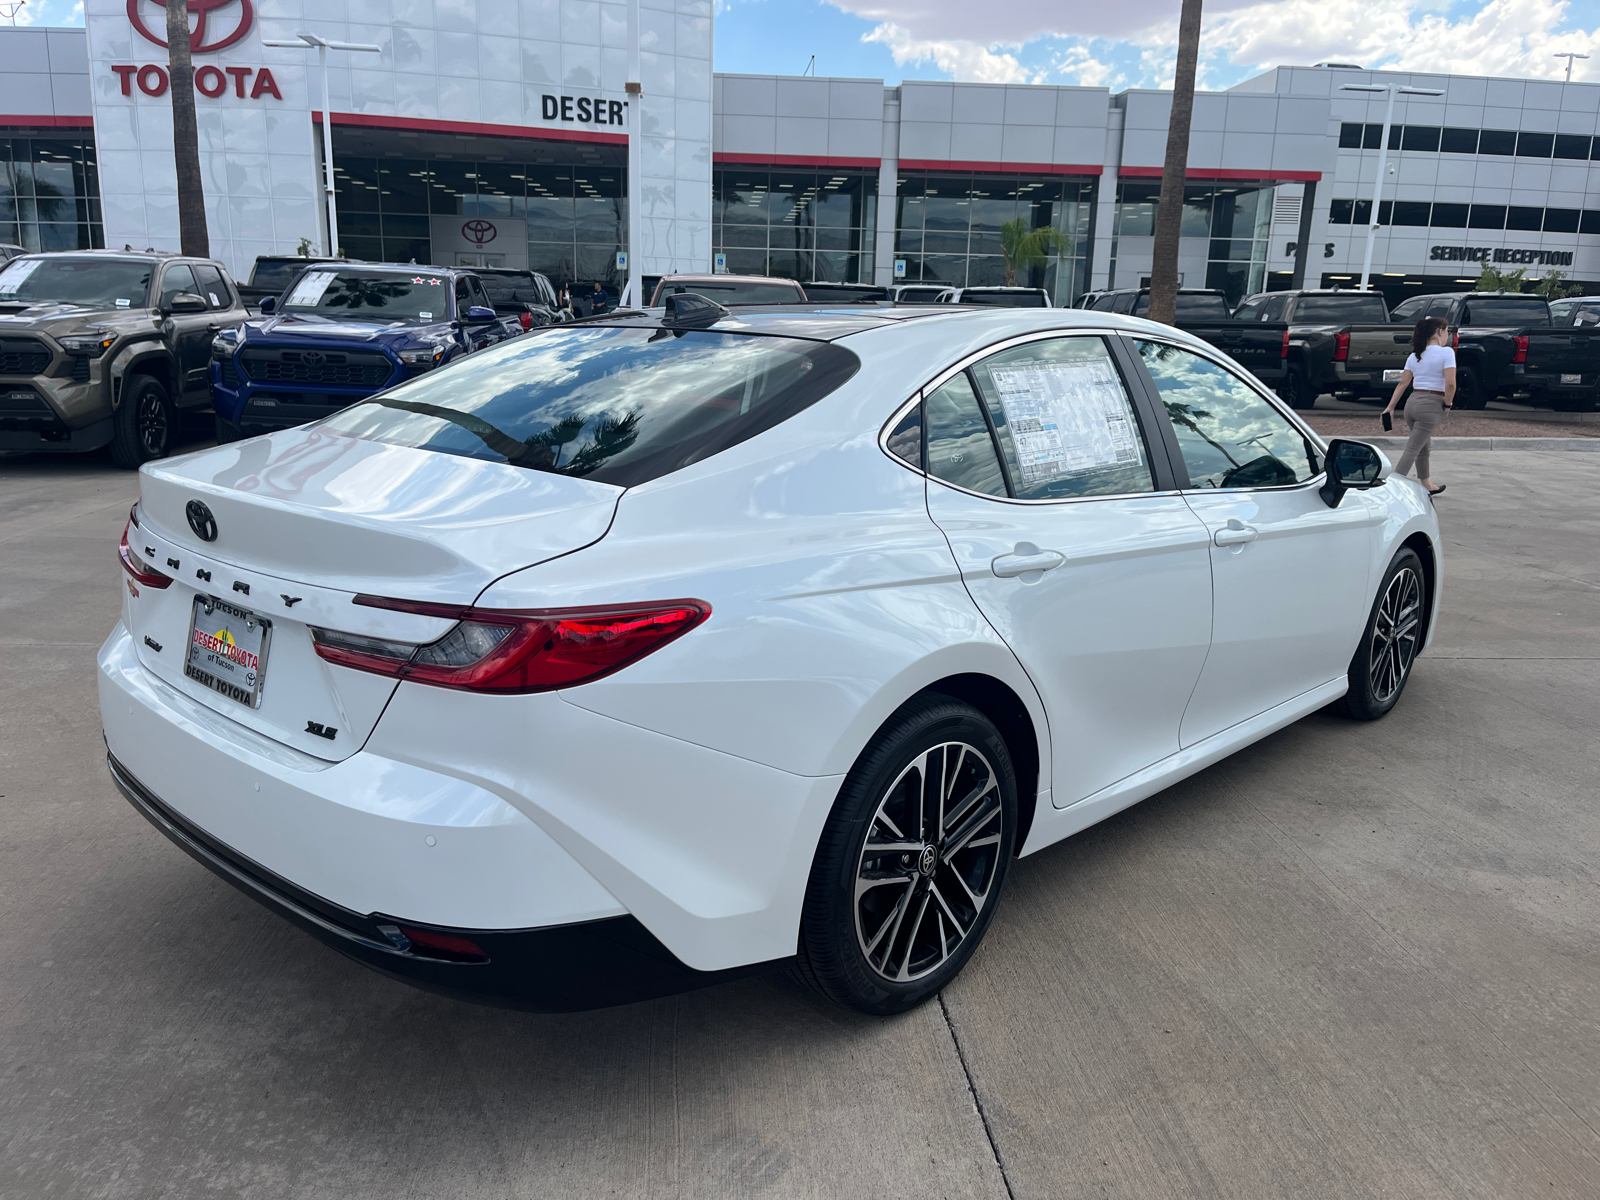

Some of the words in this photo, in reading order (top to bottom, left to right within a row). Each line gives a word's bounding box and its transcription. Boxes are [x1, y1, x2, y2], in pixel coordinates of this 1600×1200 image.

[111, 64, 283, 100] TOOTA
[1430, 245, 1492, 263] SERVICE
[1493, 248, 1574, 266] RECEPTION
[144, 546, 303, 608] CAMRY
[211, 600, 247, 620] TUCSON
[193, 629, 225, 654] DESERT
[226, 643, 258, 671] TOYOTA
[207, 654, 215, 662] of
[215, 655, 235, 672] Tucson
[186, 664, 214, 687] DESERT
[216, 679, 251, 706] TOYOTA
[303, 720, 339, 741] XLE
